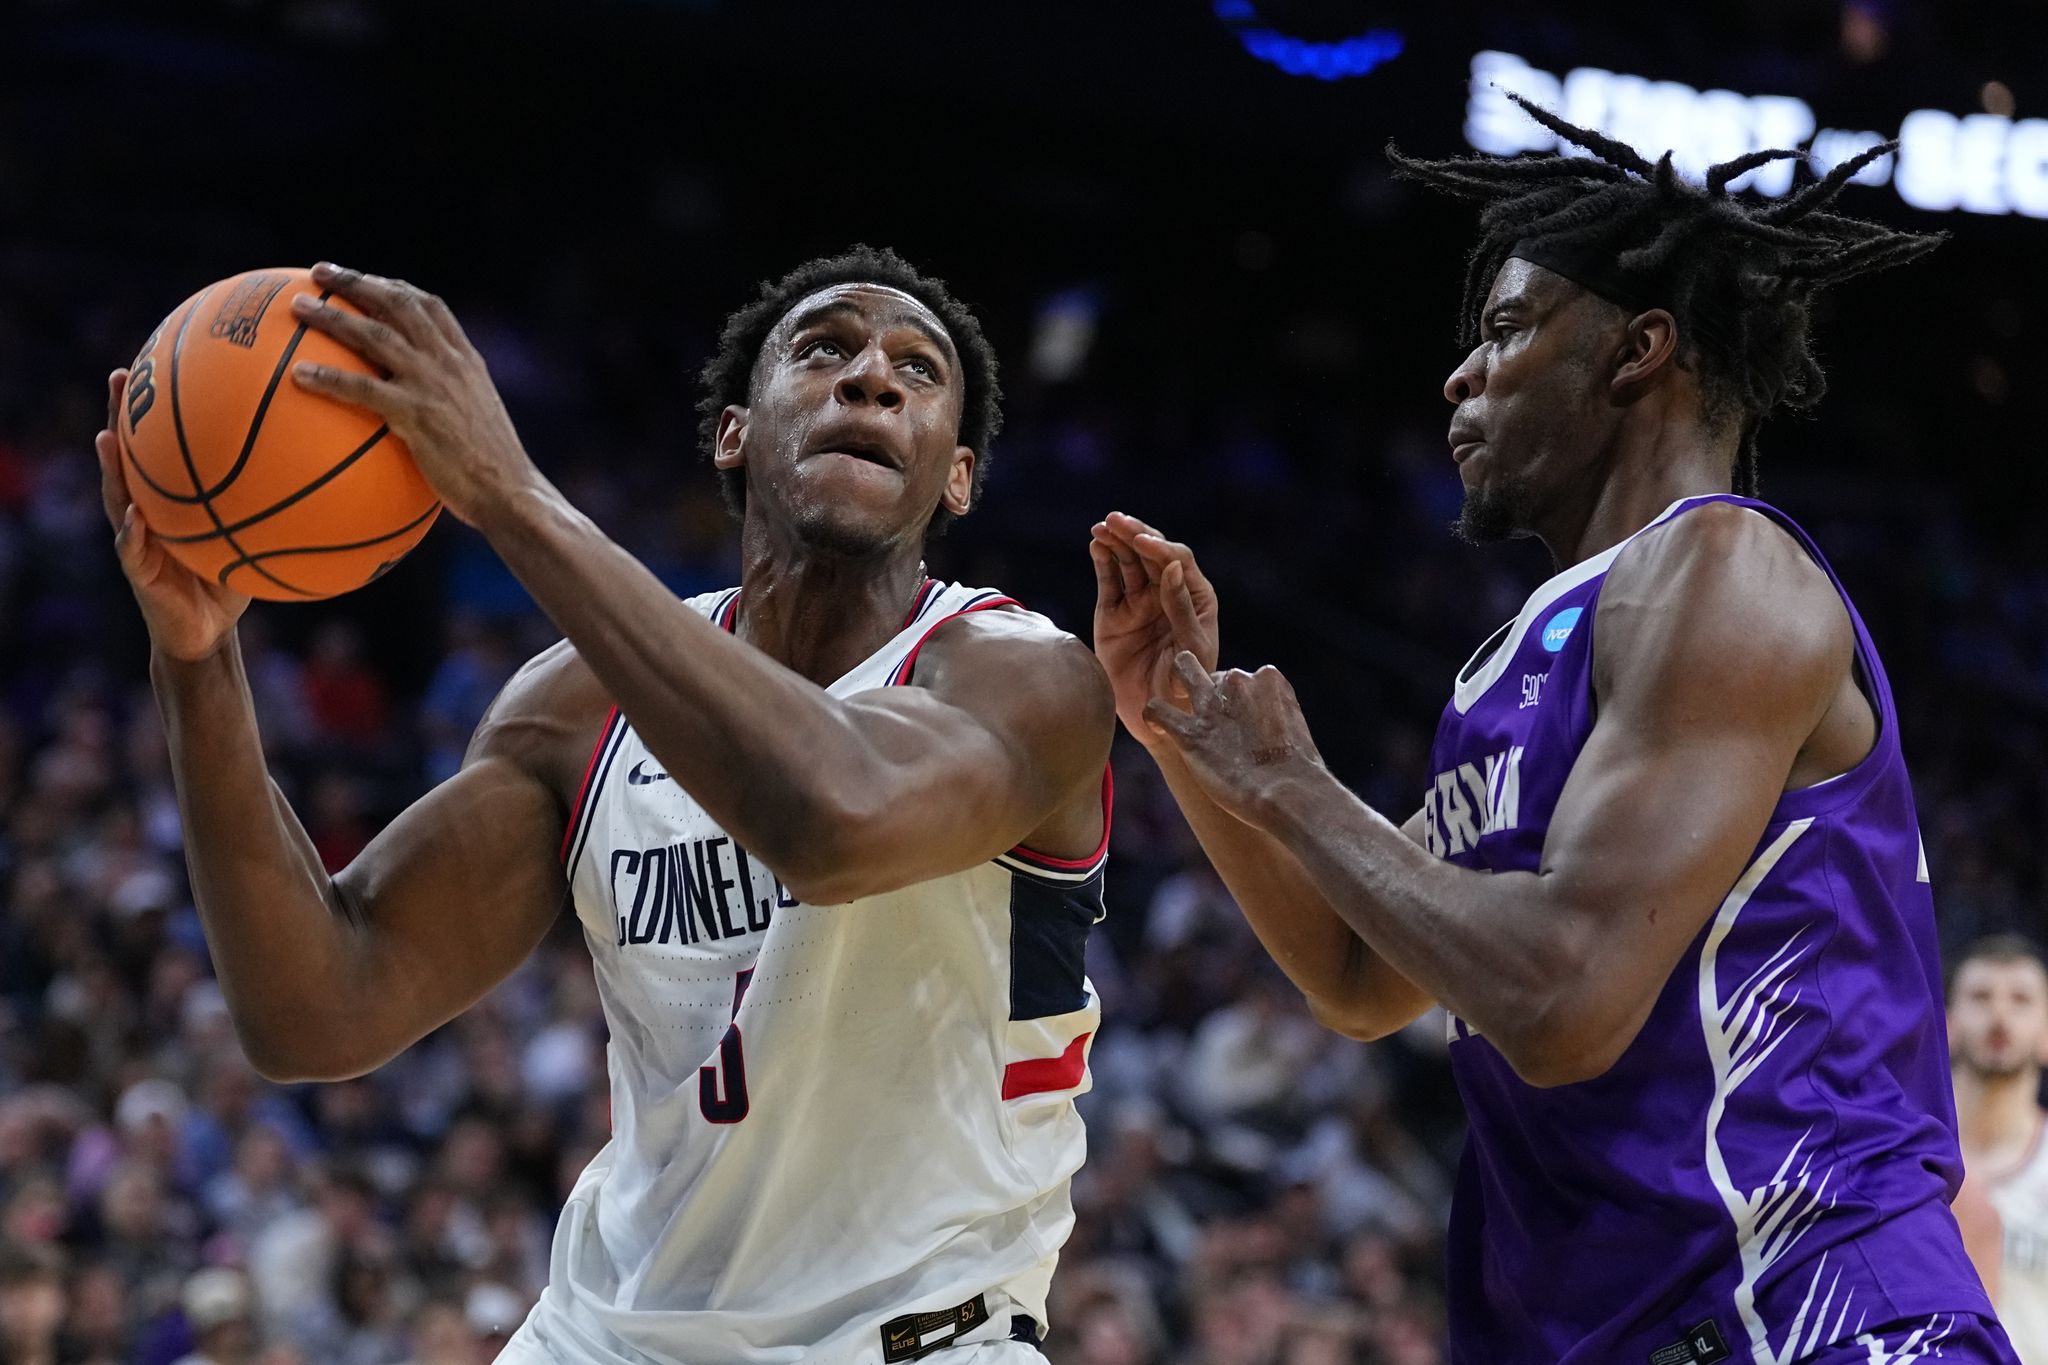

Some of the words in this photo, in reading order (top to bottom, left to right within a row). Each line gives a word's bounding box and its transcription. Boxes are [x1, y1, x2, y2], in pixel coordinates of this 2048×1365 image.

[1519, 673, 1549, 709] SOC
[961, 1301, 976, 1322] 52
[1694, 1336, 1714, 1355] XL
